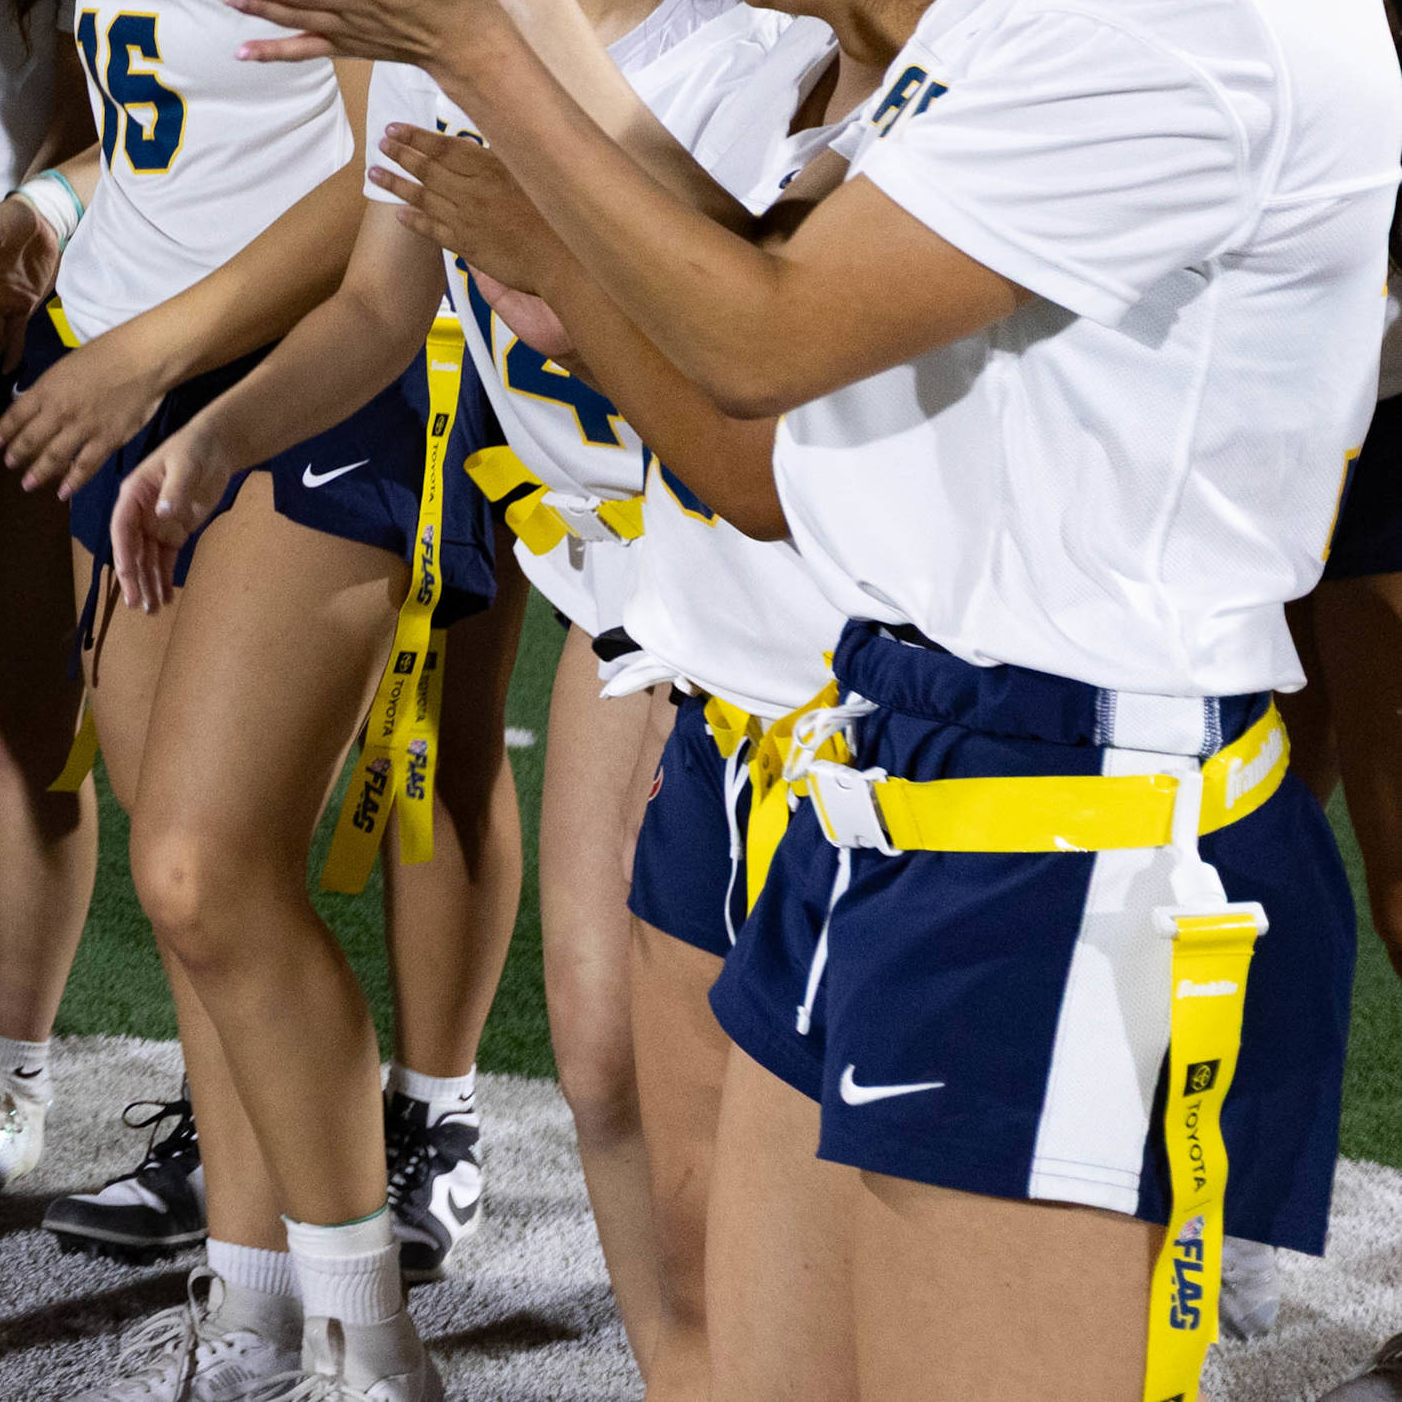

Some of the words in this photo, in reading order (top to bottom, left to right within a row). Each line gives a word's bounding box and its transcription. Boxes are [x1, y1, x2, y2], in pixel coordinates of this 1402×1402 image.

[76, 7, 189, 175] 16
[428, 442, 439, 503] TOYOTA
[417, 537, 436, 607] FLAG
[382, 679, 405, 738] TOYOTA
[352, 766, 388, 834] FLAG
[406, 750, 428, 801] FLAG
[1185, 1100, 1207, 1193] TOYOTA
[1169, 1237, 1205, 1332] FLAG
